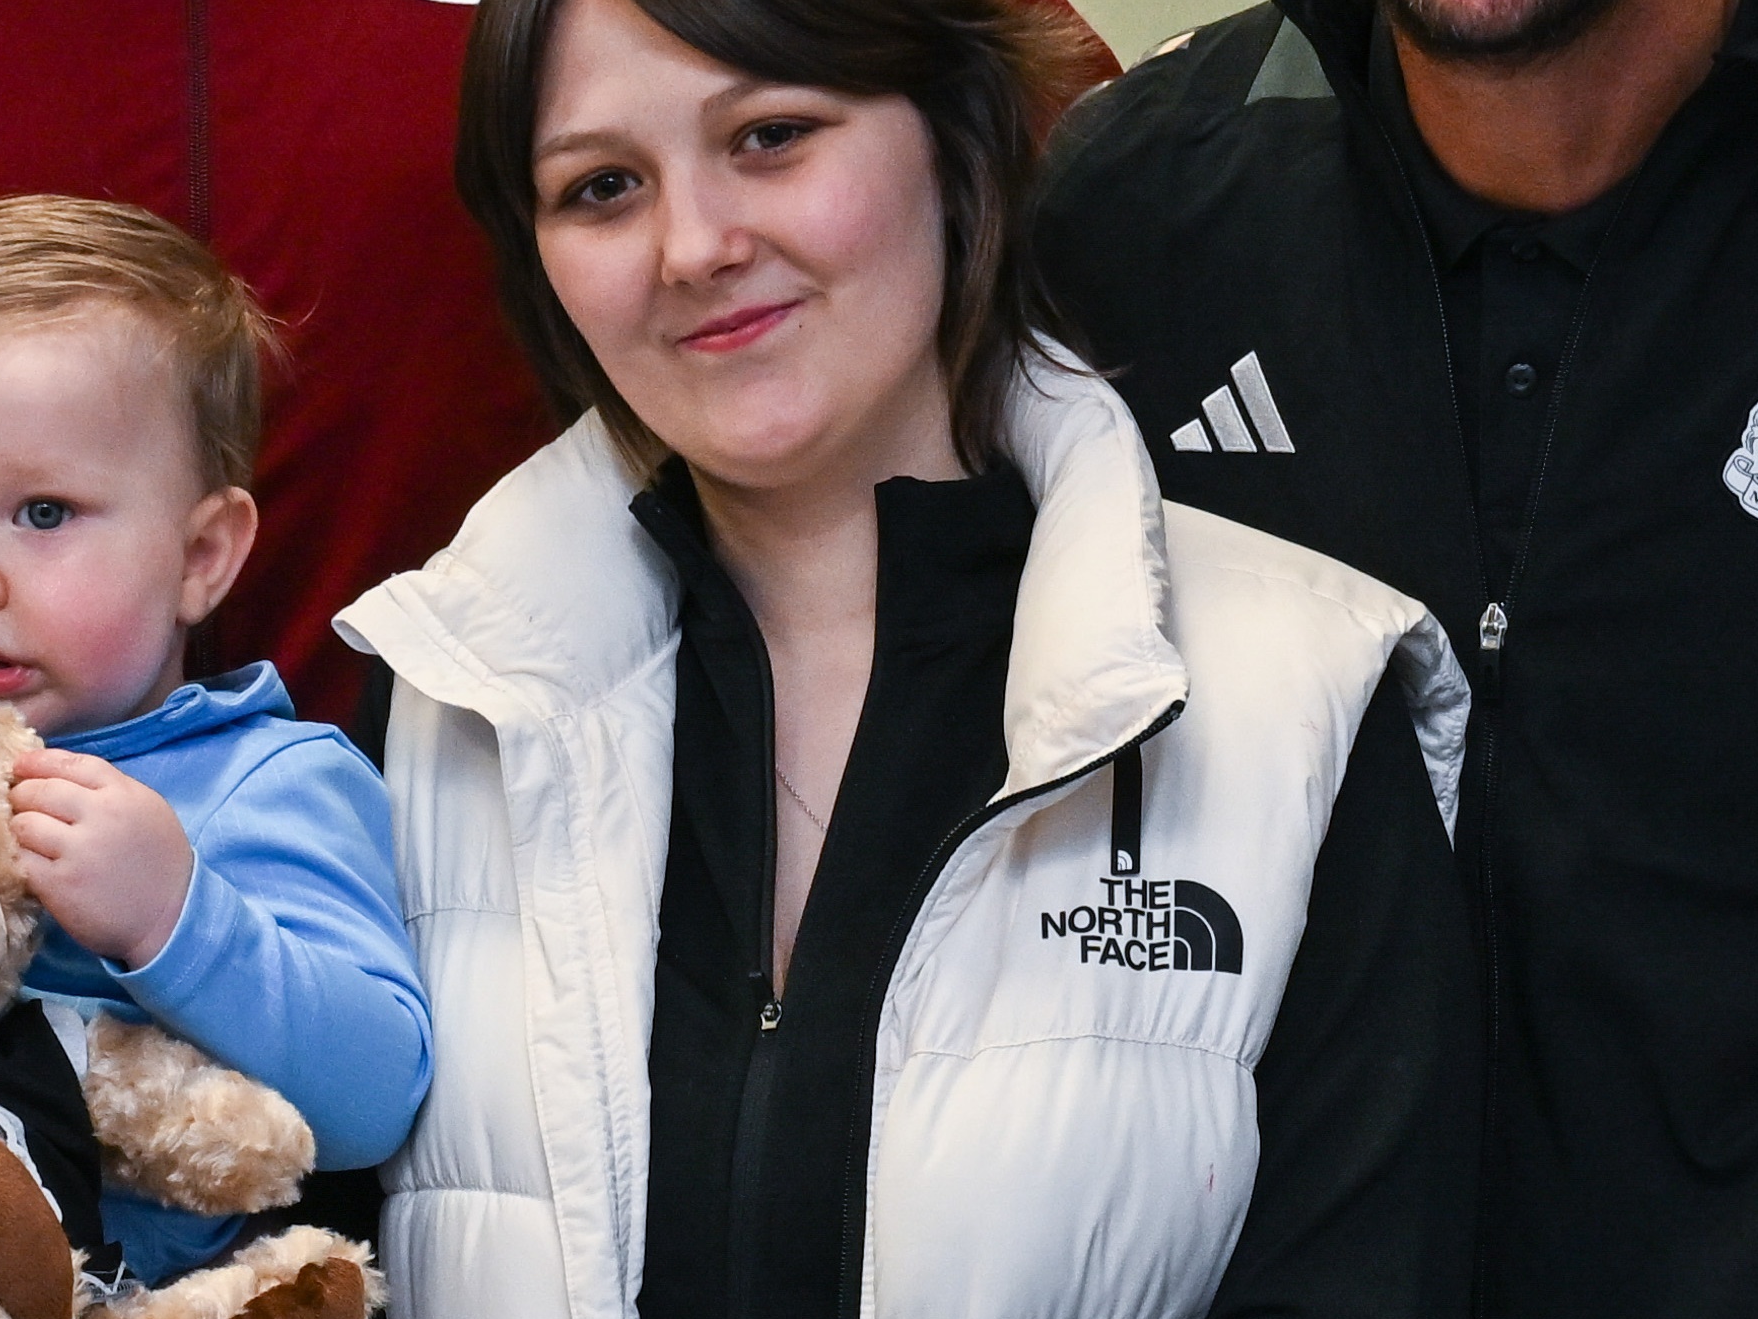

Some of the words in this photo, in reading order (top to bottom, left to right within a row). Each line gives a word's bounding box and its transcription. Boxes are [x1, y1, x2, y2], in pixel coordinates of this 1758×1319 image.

[1099, 877, 1171, 909] THE
[1041, 906, 1171, 940] NORTH
[1080, 935, 1170, 972] FACE
